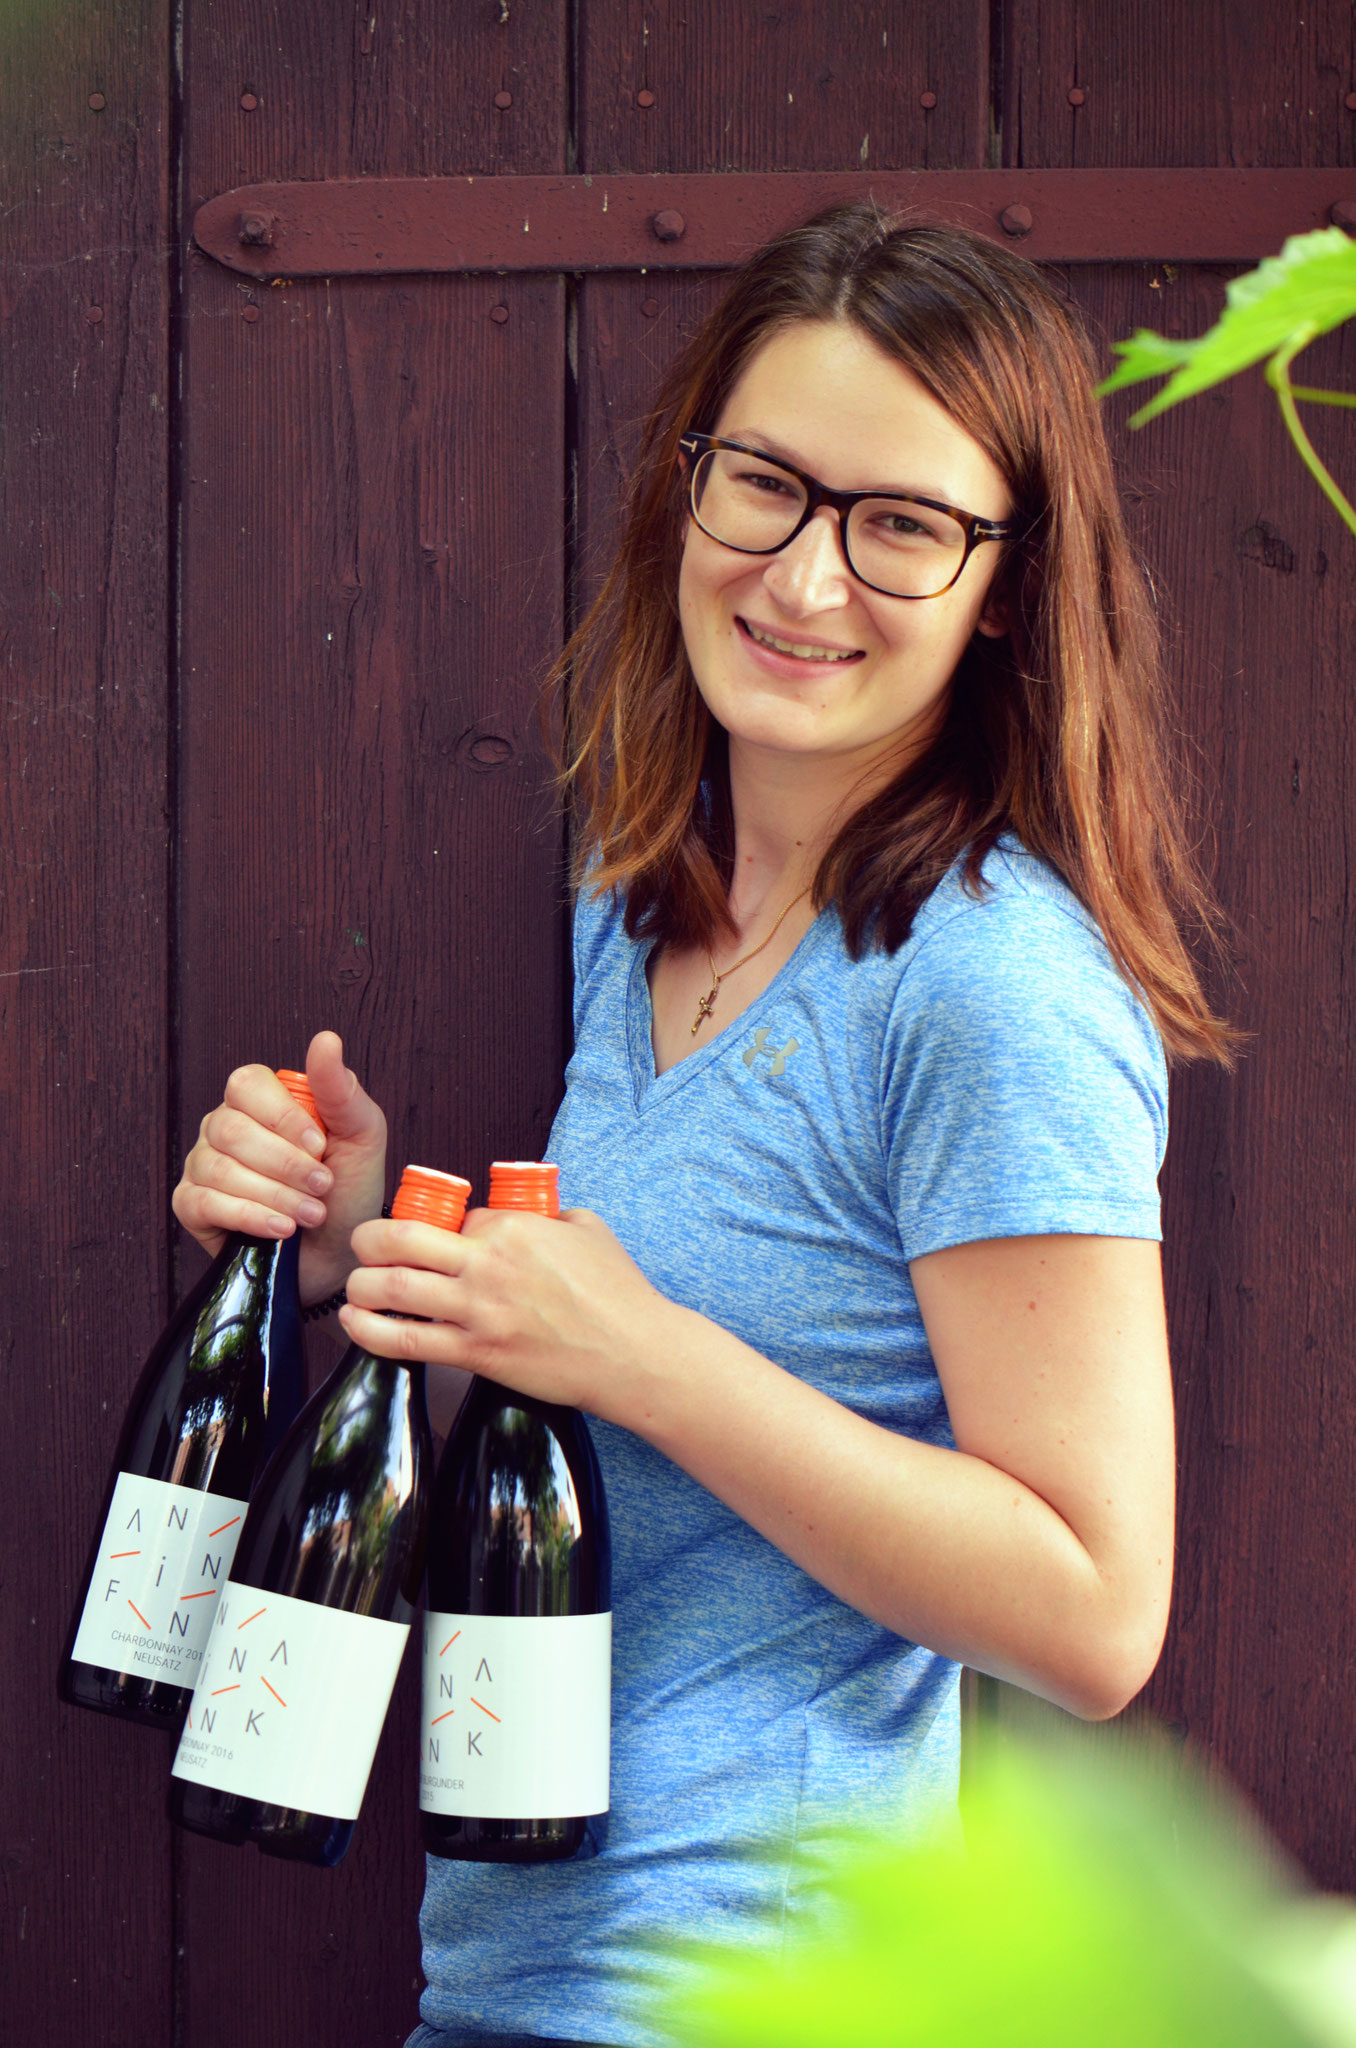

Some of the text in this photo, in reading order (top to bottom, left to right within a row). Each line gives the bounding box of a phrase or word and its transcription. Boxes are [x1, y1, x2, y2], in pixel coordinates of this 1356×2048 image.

[111, 1629, 203, 1662] CHARDONNAY 201
[133, 1650, 182, 1672] NEUSATZ
[211, 1744, 235, 1761] 2016
